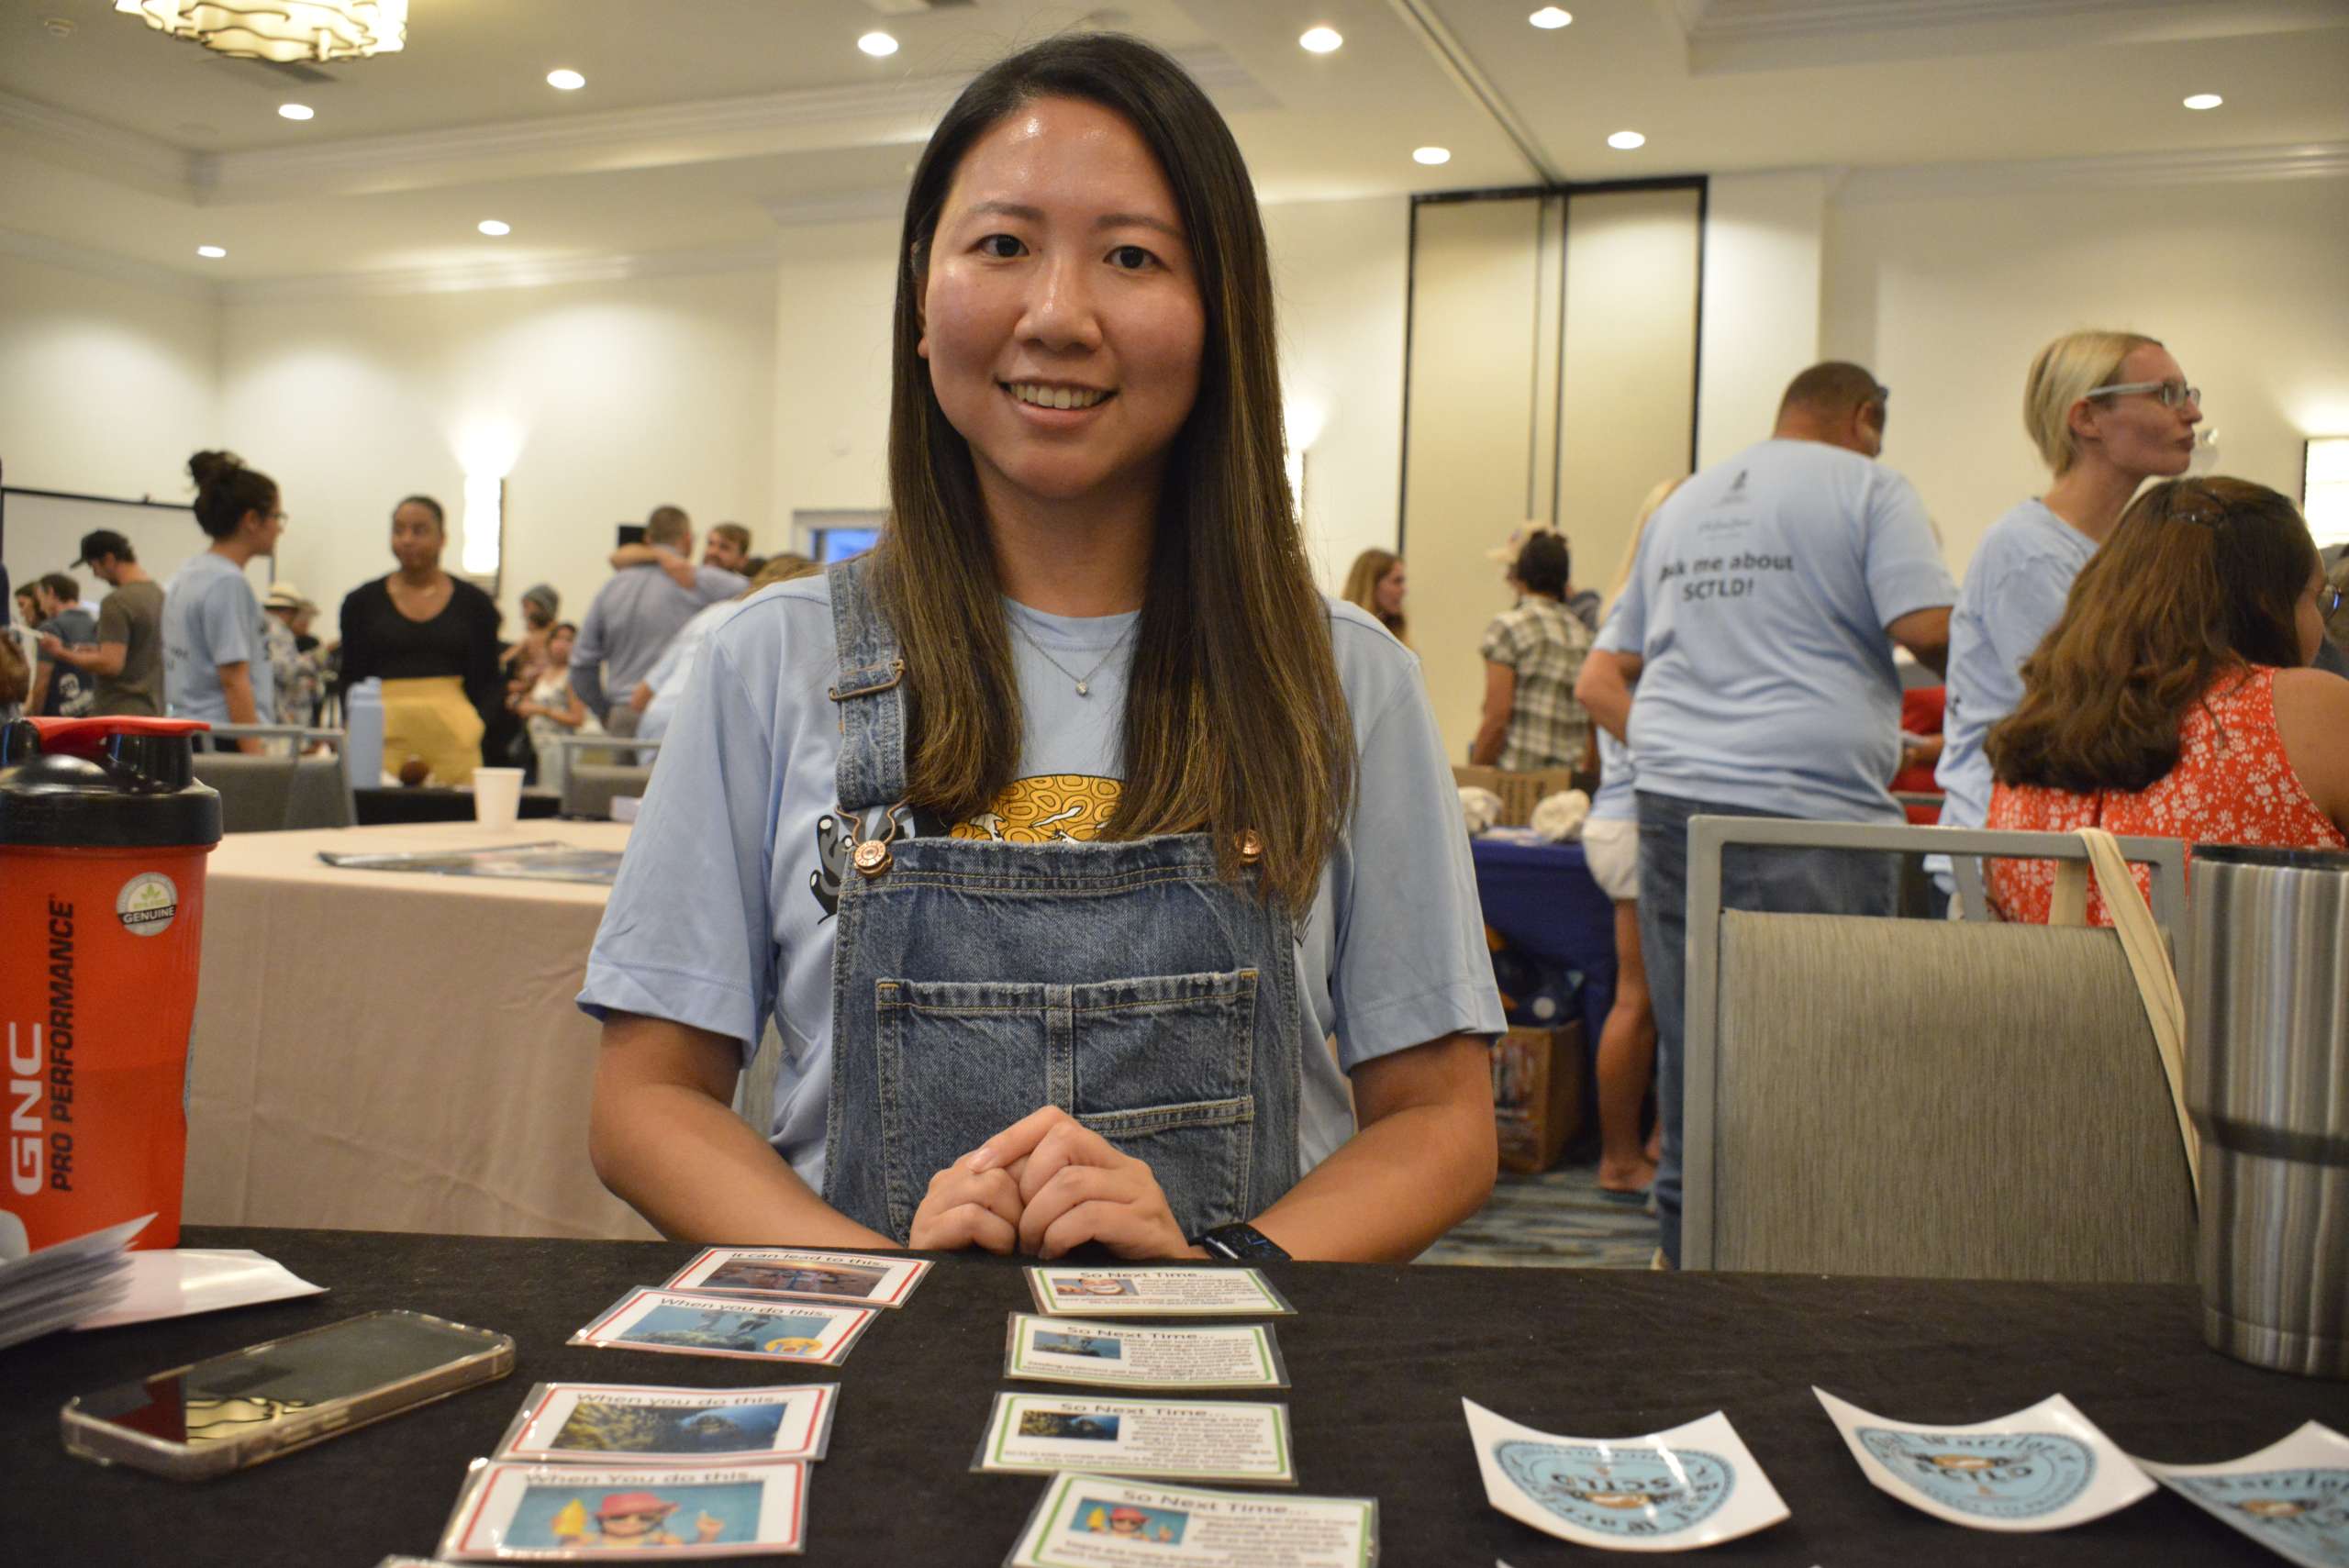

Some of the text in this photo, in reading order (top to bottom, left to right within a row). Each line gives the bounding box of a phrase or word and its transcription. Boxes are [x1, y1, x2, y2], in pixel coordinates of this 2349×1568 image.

[1693, 556, 1722, 573] me
[1729, 552, 1795, 572] about
[1683, 577, 1754, 602] SCTLD!
[122, 906, 175, 924] GENUINE
[49, 900, 74, 1192] PRO PERFORMANCE
[9, 1021, 44, 1195] GNC
[783, 1251, 821, 1261] lead
[825, 1254, 844, 1262] to
[660, 1298, 713, 1309] When
[719, 1304, 754, 1313] you
[760, 1305, 784, 1313] do
[1067, 1326, 1091, 1335] So
[1097, 1329, 1142, 1339] Next
[576, 1393, 642, 1404] When
[648, 1396, 690, 1407] you
[697, 1395, 726, 1405] do
[1061, 1403, 1086, 1412] So
[1095, 1405, 1145, 1415] Next
[524, 1473, 597, 1485] When
[662, 1473, 696, 1484] do
[1123, 1490, 1152, 1504] So
[1160, 1495, 1219, 1512] Next
